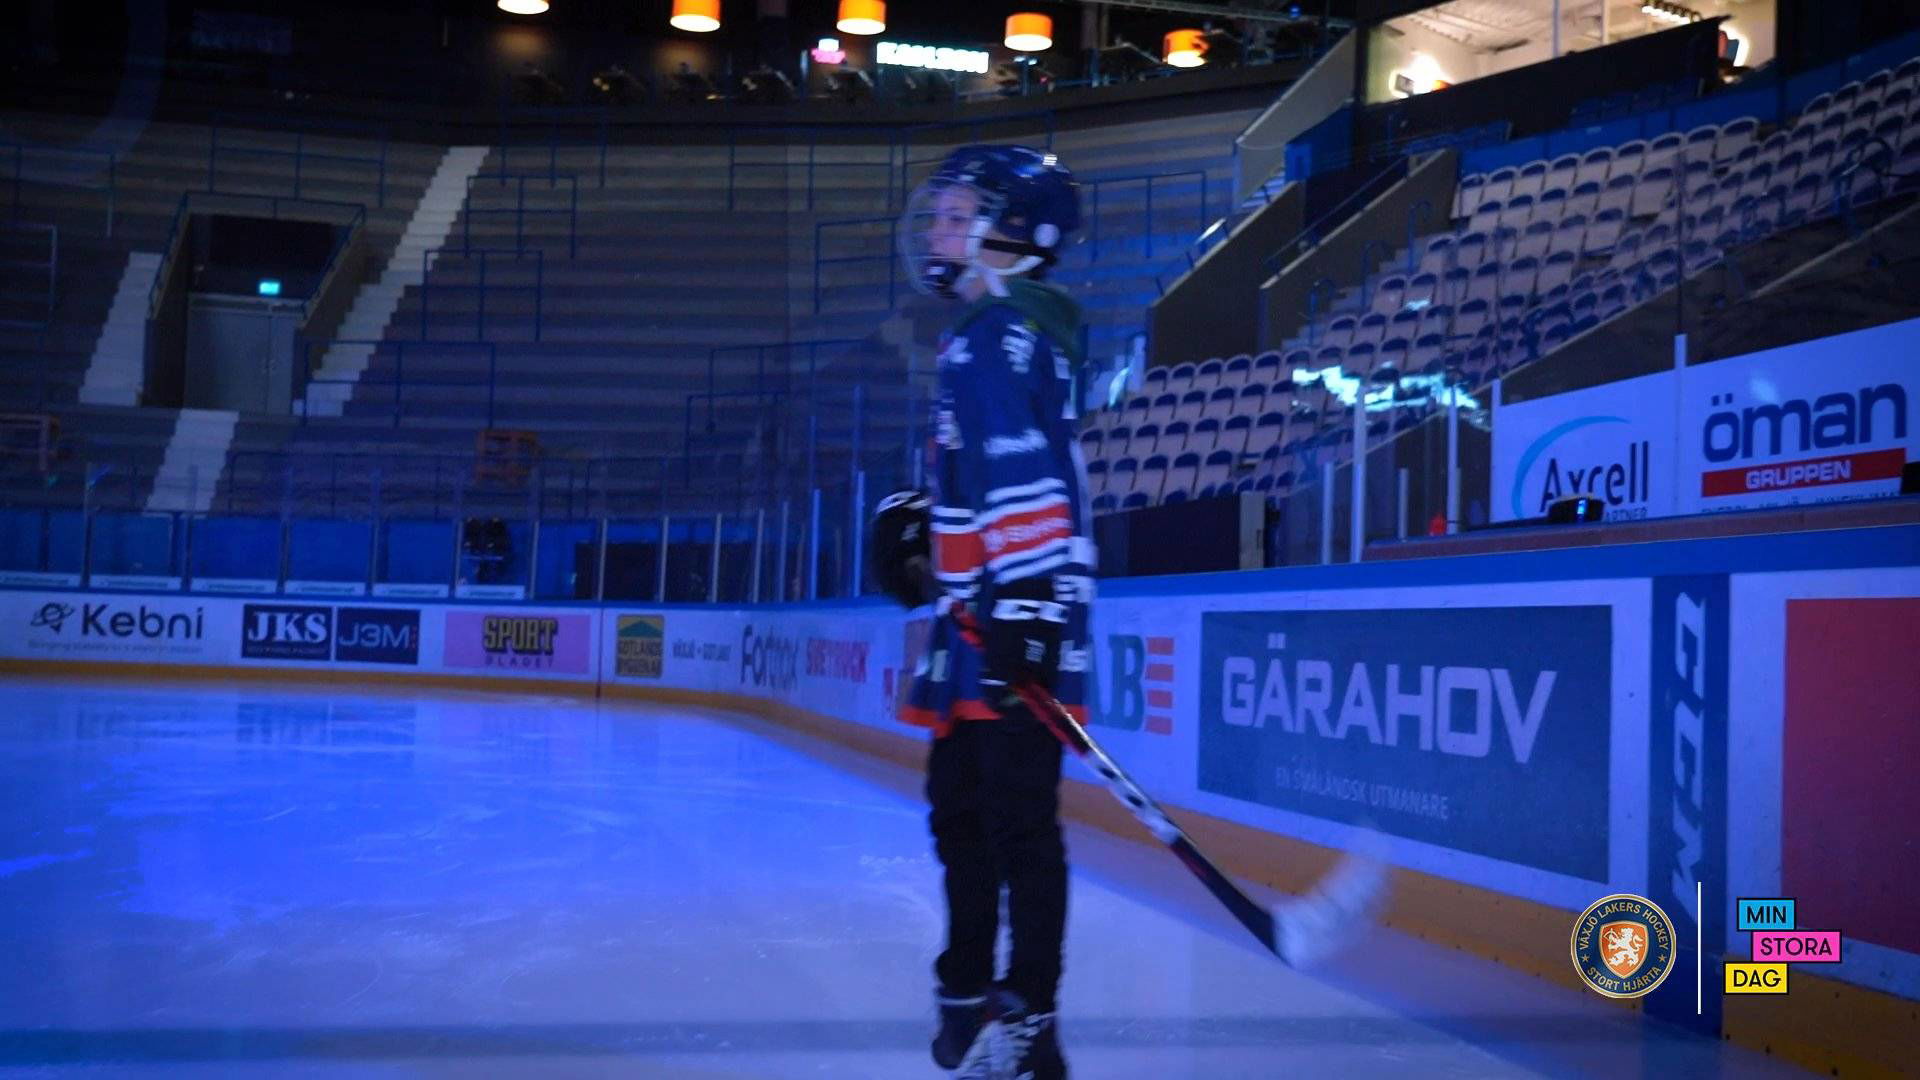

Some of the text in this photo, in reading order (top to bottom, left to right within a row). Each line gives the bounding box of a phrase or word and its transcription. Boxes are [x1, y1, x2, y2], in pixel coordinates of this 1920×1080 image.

[1703, 383, 1907, 463] öman
[1539, 440, 1649, 513] Axcell
[1745, 460, 1851, 490] GRUPPEN
[1603, 507, 1648, 522] ARTNER
[82, 603, 204, 639] Kebni
[247, 611, 328, 643] JKS
[338, 623, 410, 649] J3M
[482, 615, 558, 656] SPORT
[1221, 632, 1557, 765] GÄRAHOV
[1672, 591, 1706, 924] CCM
